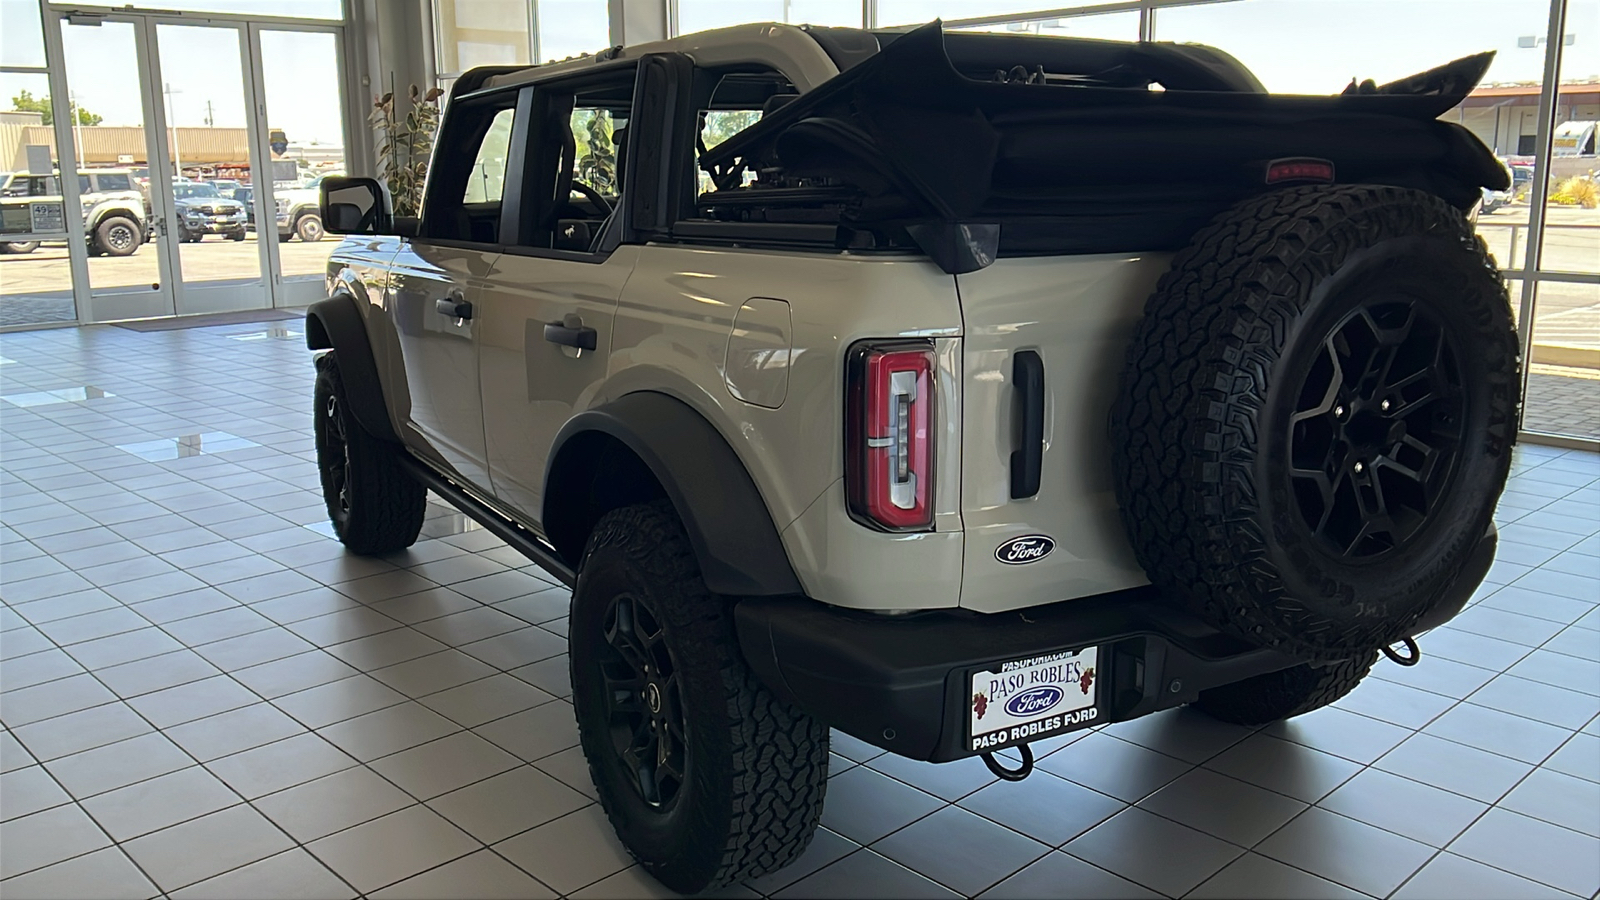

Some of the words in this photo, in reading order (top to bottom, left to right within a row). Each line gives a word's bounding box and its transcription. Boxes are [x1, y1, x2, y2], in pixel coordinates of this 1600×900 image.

[1007, 540, 1045, 560] Ford
[989, 673, 1024, 703] PASO
[1030, 661, 1081, 684] ROBLES
[1017, 690, 1053, 712] Ford
[972, 731, 1008, 751] PASO
[1011, 716, 1061, 740] ROBLES
[1064, 707, 1098, 727] FORD
